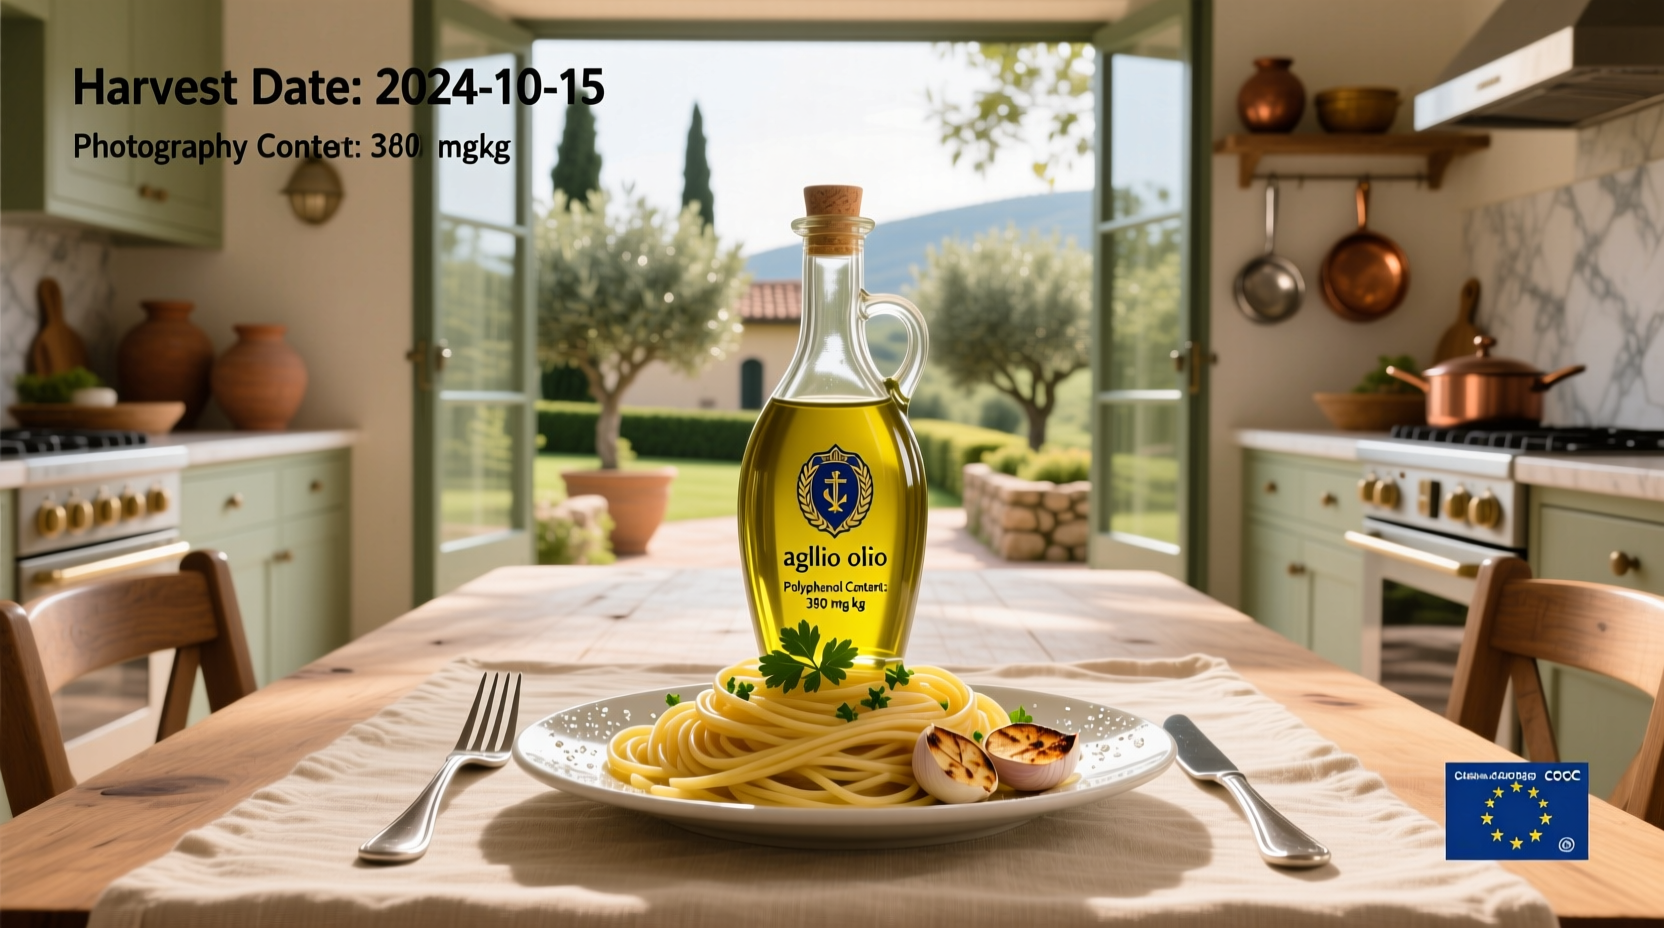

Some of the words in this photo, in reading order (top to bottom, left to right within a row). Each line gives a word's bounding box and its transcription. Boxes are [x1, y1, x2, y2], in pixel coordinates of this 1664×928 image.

[848, 546, 887, 567] olio
[784, 580, 843, 595] Polyphenol
[852, 597, 865, 612] kg
